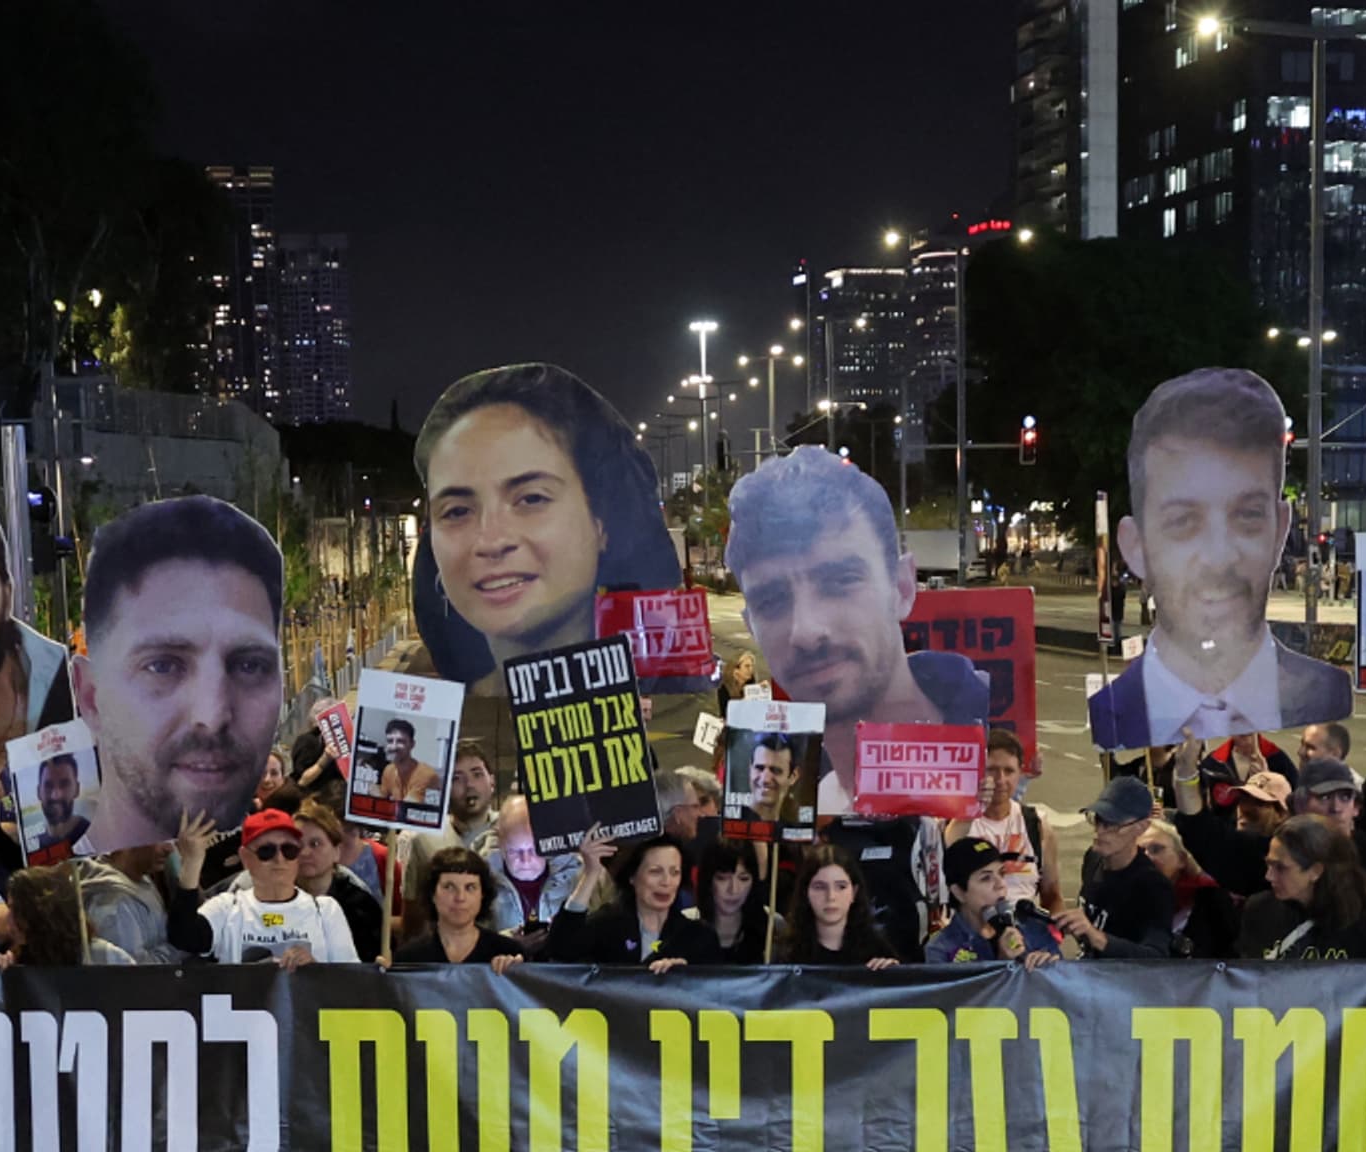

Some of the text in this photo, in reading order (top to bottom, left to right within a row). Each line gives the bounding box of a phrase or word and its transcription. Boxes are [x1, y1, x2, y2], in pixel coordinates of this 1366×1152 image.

[902, 616, 1015, 652] קודם
[506, 643, 631, 706] עופר בבית!
[516, 692, 639, 751] אבל מחזירים
[522, 732, 650, 804] את כולם!
[866, 743, 974, 765] עד החטוף
[877, 770, 963, 792] האחרון
[538, 834, 566, 854] UNTIL
